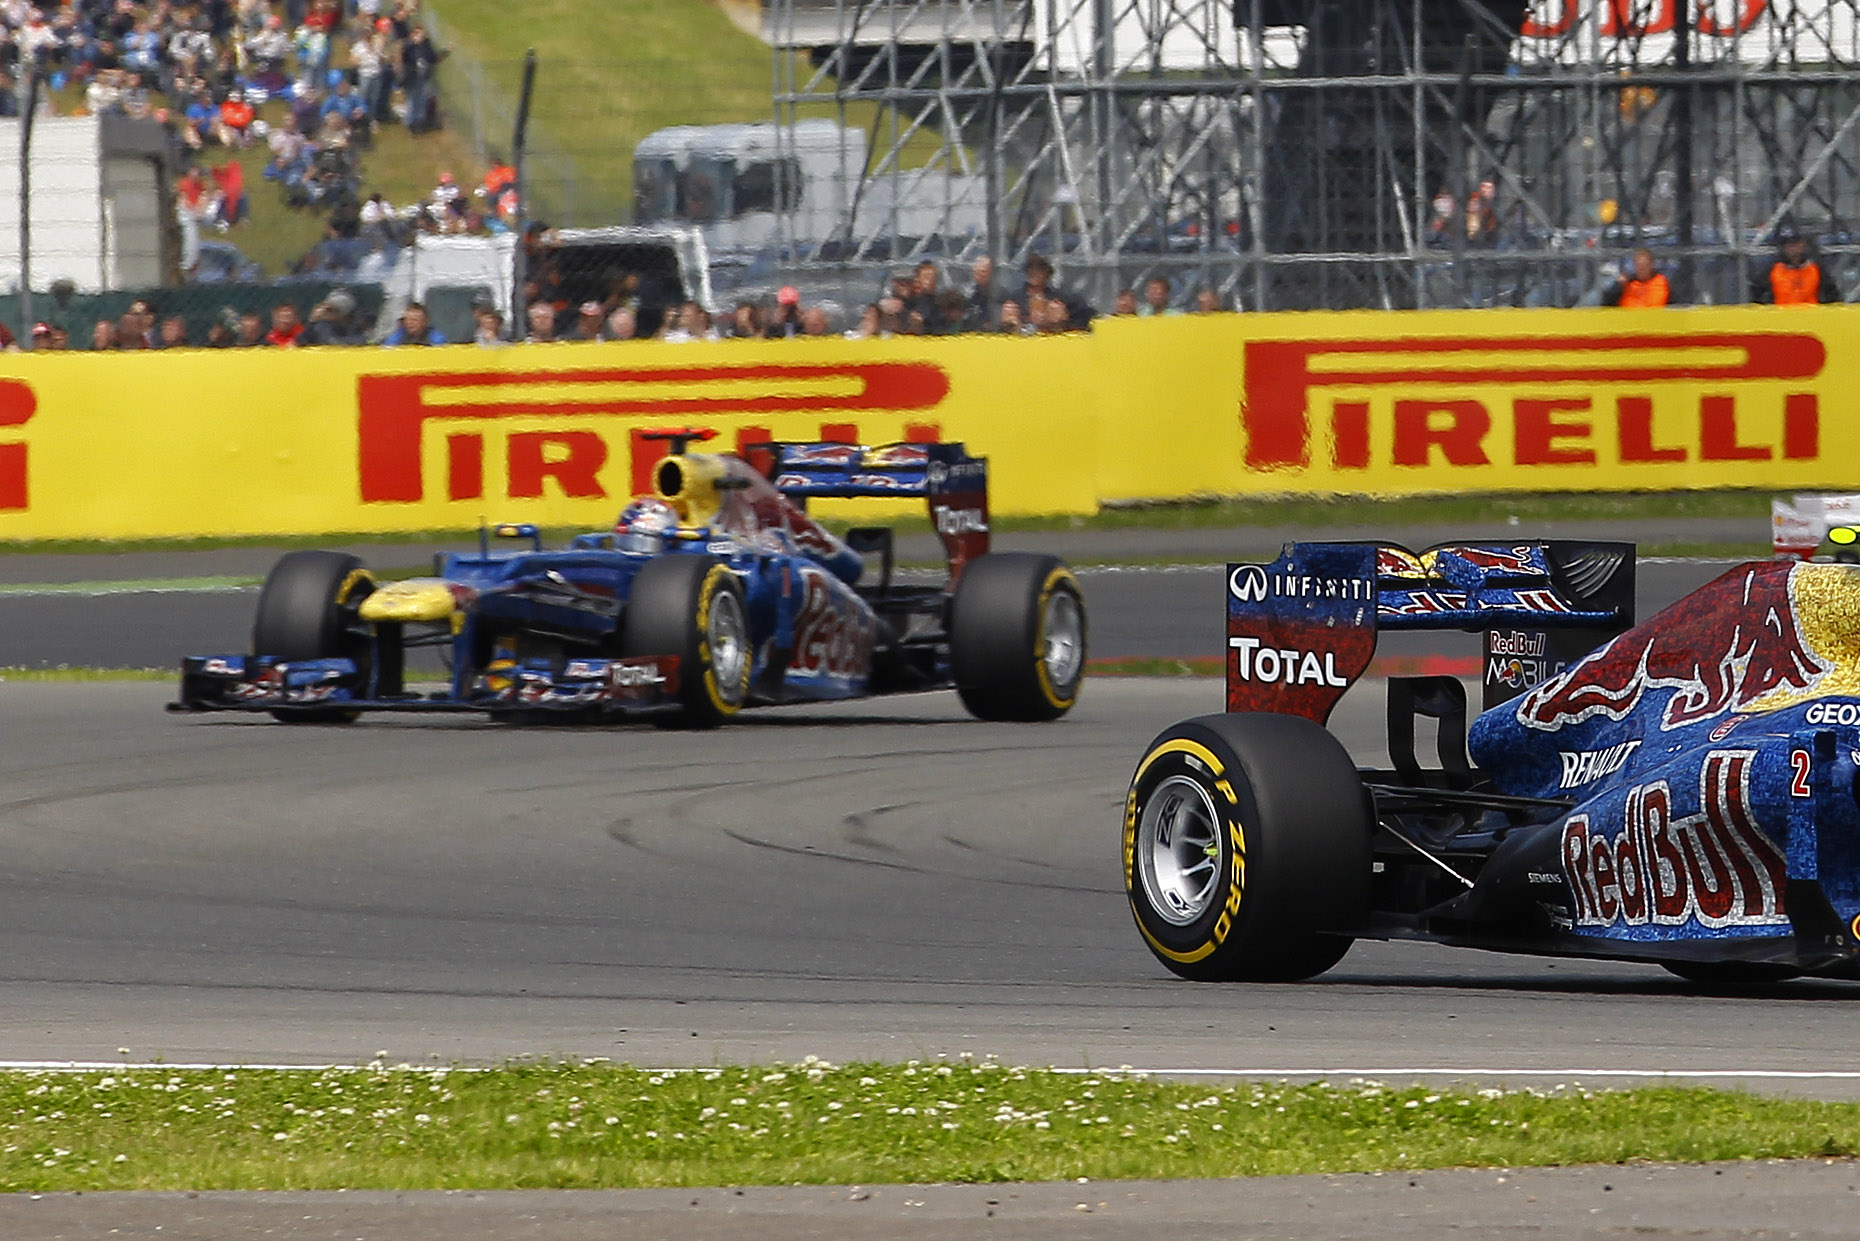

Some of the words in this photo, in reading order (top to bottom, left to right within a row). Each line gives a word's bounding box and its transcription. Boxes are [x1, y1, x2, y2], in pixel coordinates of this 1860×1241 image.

[1242, 333, 1826, 471] PIRELLI
[1275, 574, 1371, 600] INFINITI
[1229, 637, 1347, 687] TOTAL
[1559, 740, 1642, 789] RENAULT
[1791, 749, 1810, 797] 2
[1213, 819, 1246, 945] ZERO
[1528, 872, 1562, 884] SIEMENS
